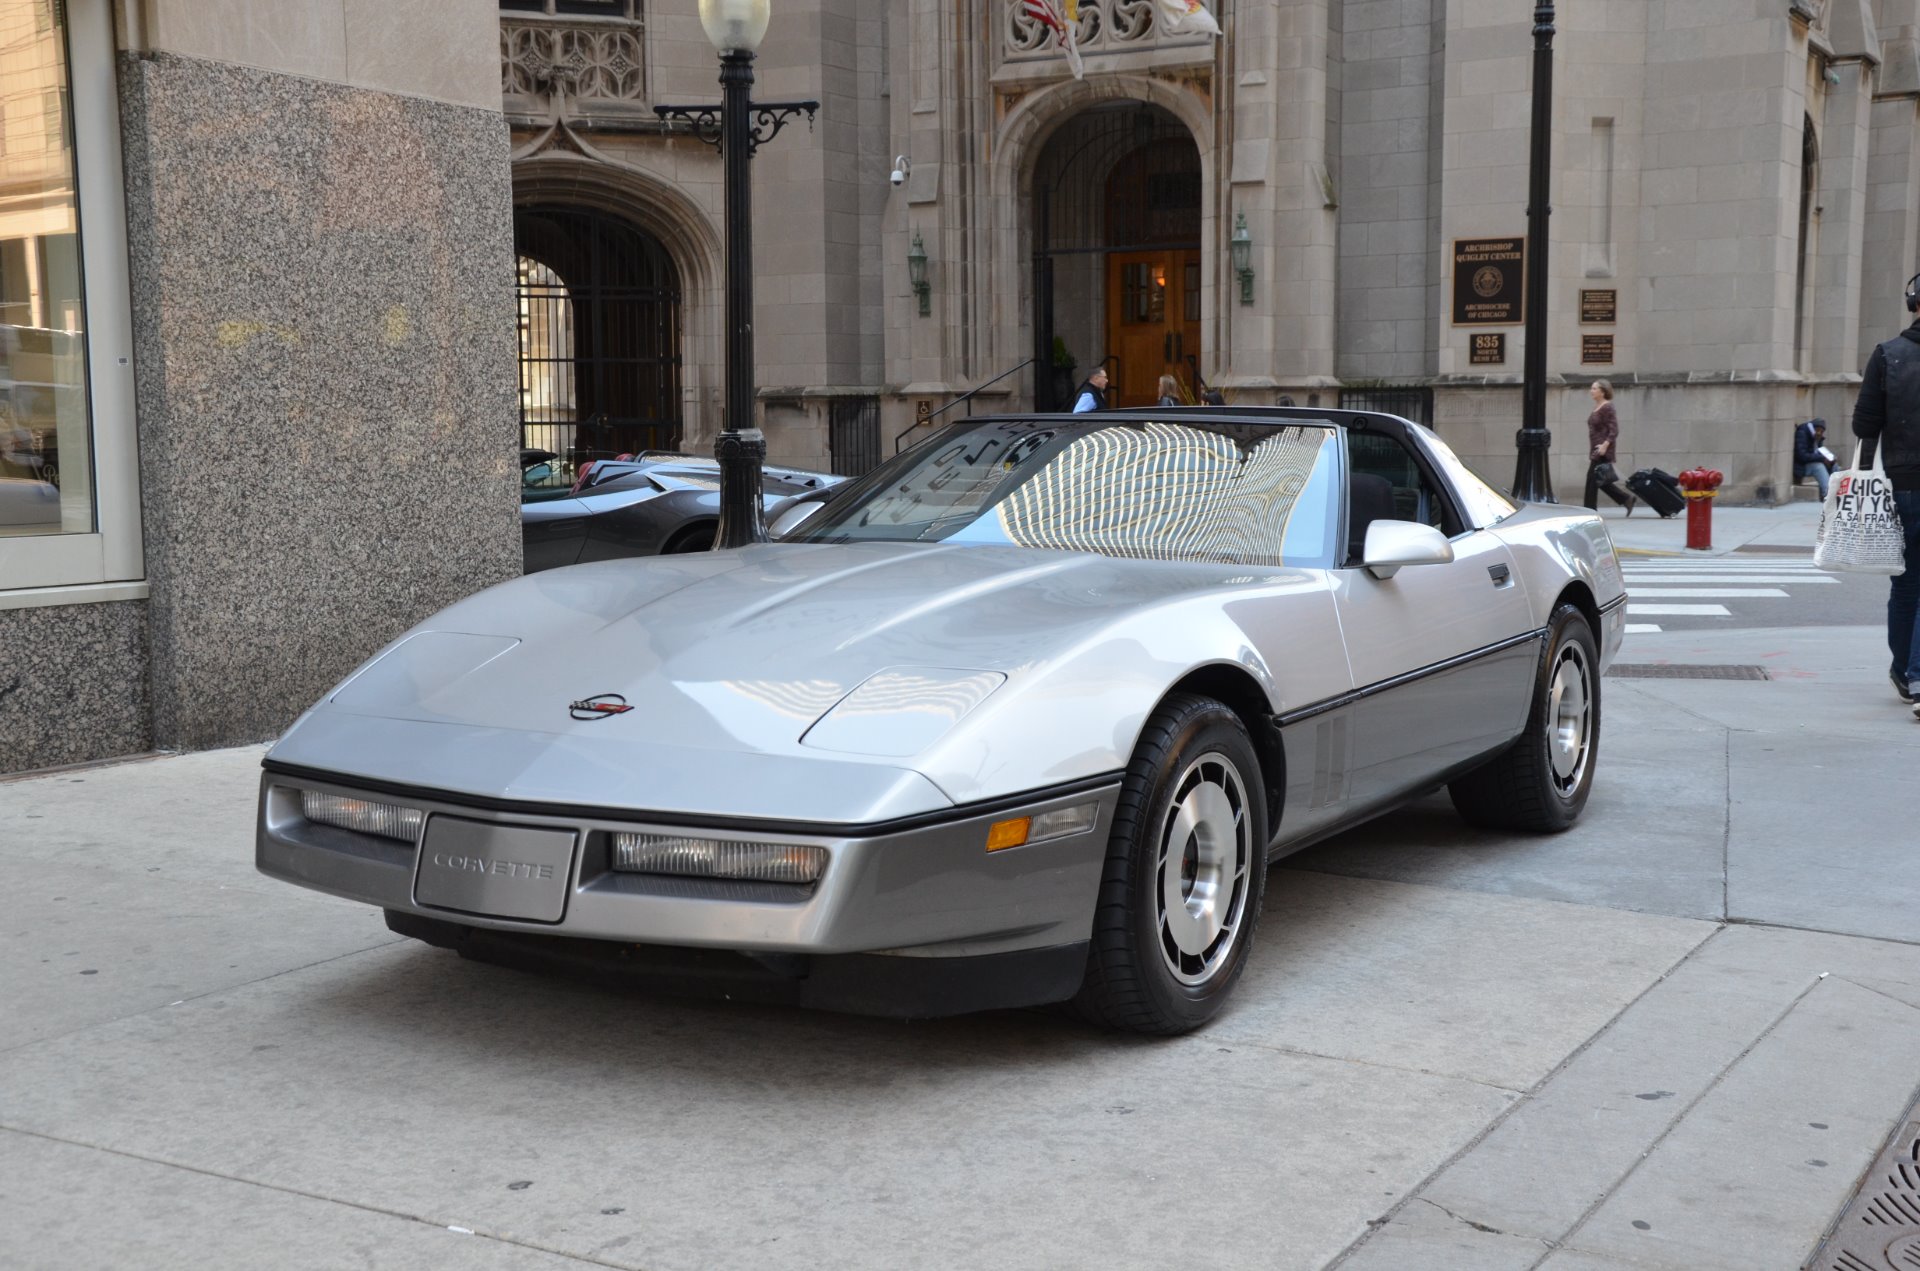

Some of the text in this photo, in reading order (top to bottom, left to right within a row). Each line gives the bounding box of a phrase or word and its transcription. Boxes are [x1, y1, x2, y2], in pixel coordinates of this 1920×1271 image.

[1464, 242, 1514, 252] ARCHBISHOP
[1456, 252, 1521, 263] QUIGLEY CENTER
[1475, 335, 1499, 348] 835
[434, 852, 553, 879] CORVETTE
